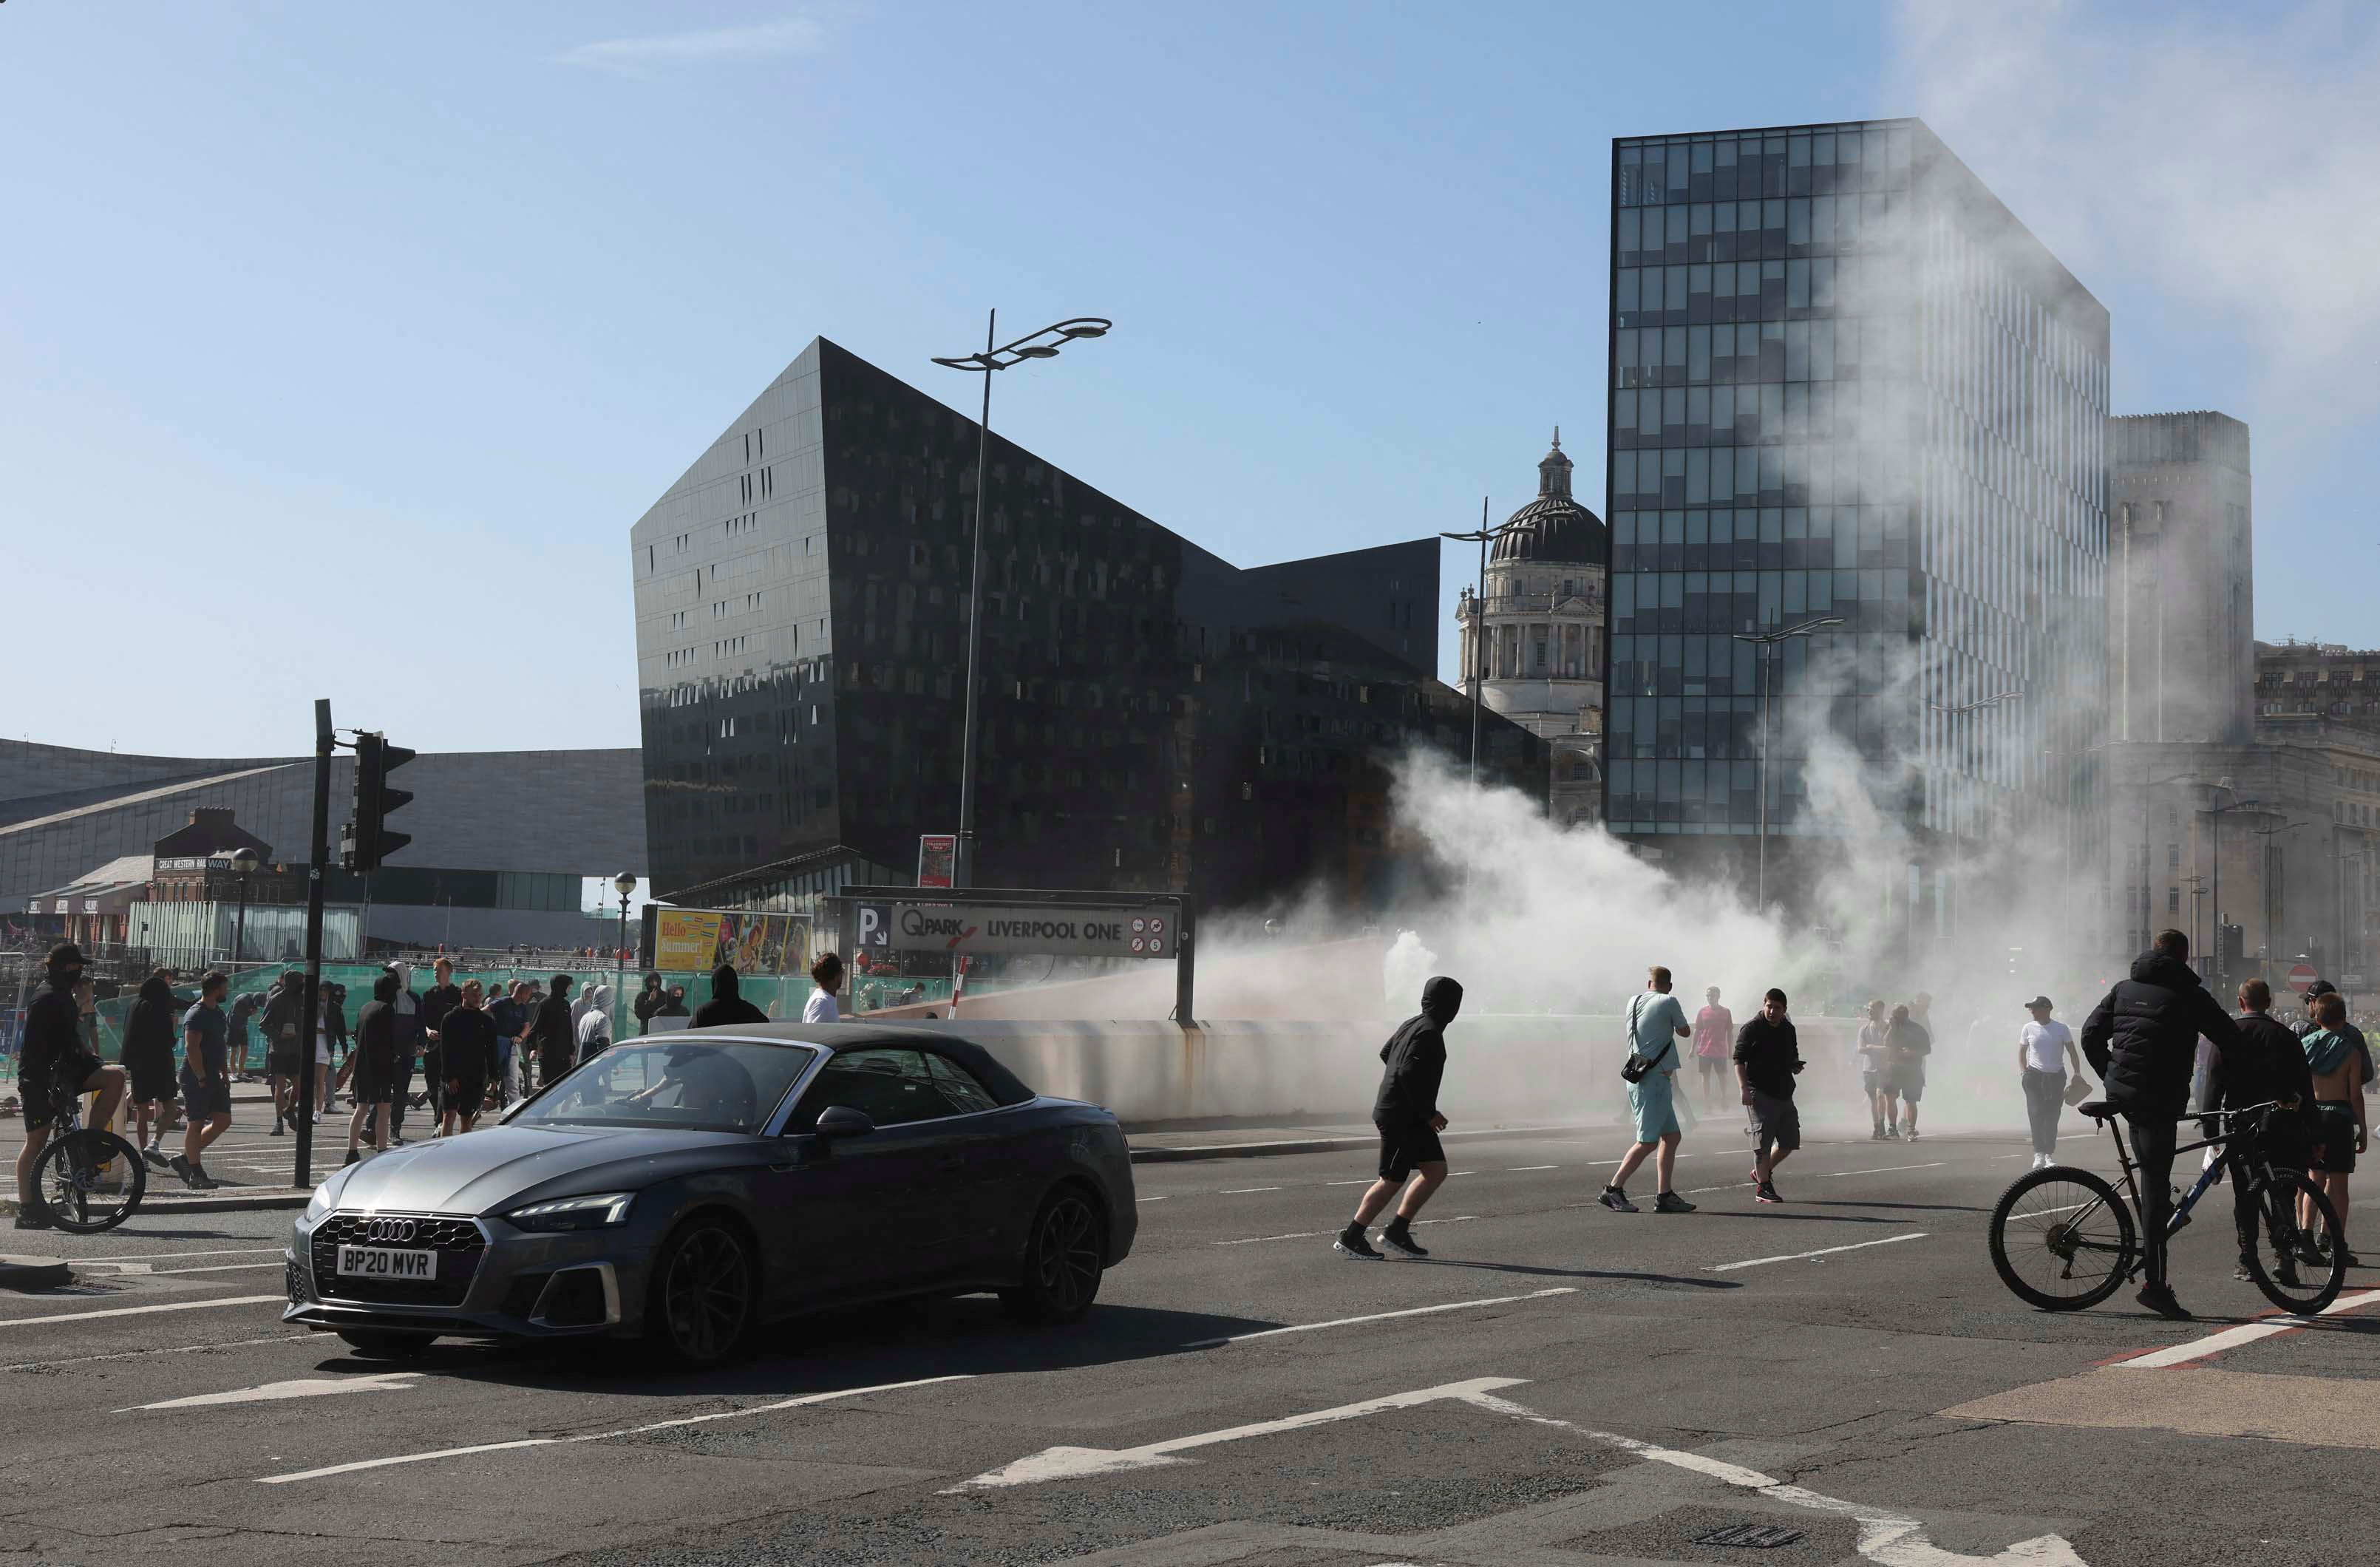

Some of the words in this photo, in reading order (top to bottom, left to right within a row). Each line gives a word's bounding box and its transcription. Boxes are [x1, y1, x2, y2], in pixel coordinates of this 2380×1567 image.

[159, 860, 173, 869] GREAT
[174, 859, 195, 869] WESTERN
[662, 922, 686, 937] Hello
[859, 908, 879, 945] P
[987, 920, 1078, 939] LIVERPOOL
[1083, 922, 1122, 940] ONE
[662, 938, 701, 954] Summer!
[1153, 941, 1158, 950] 5
[344, 1249, 388, 1274] BP20
[392, 1252, 429, 1276] MVR
